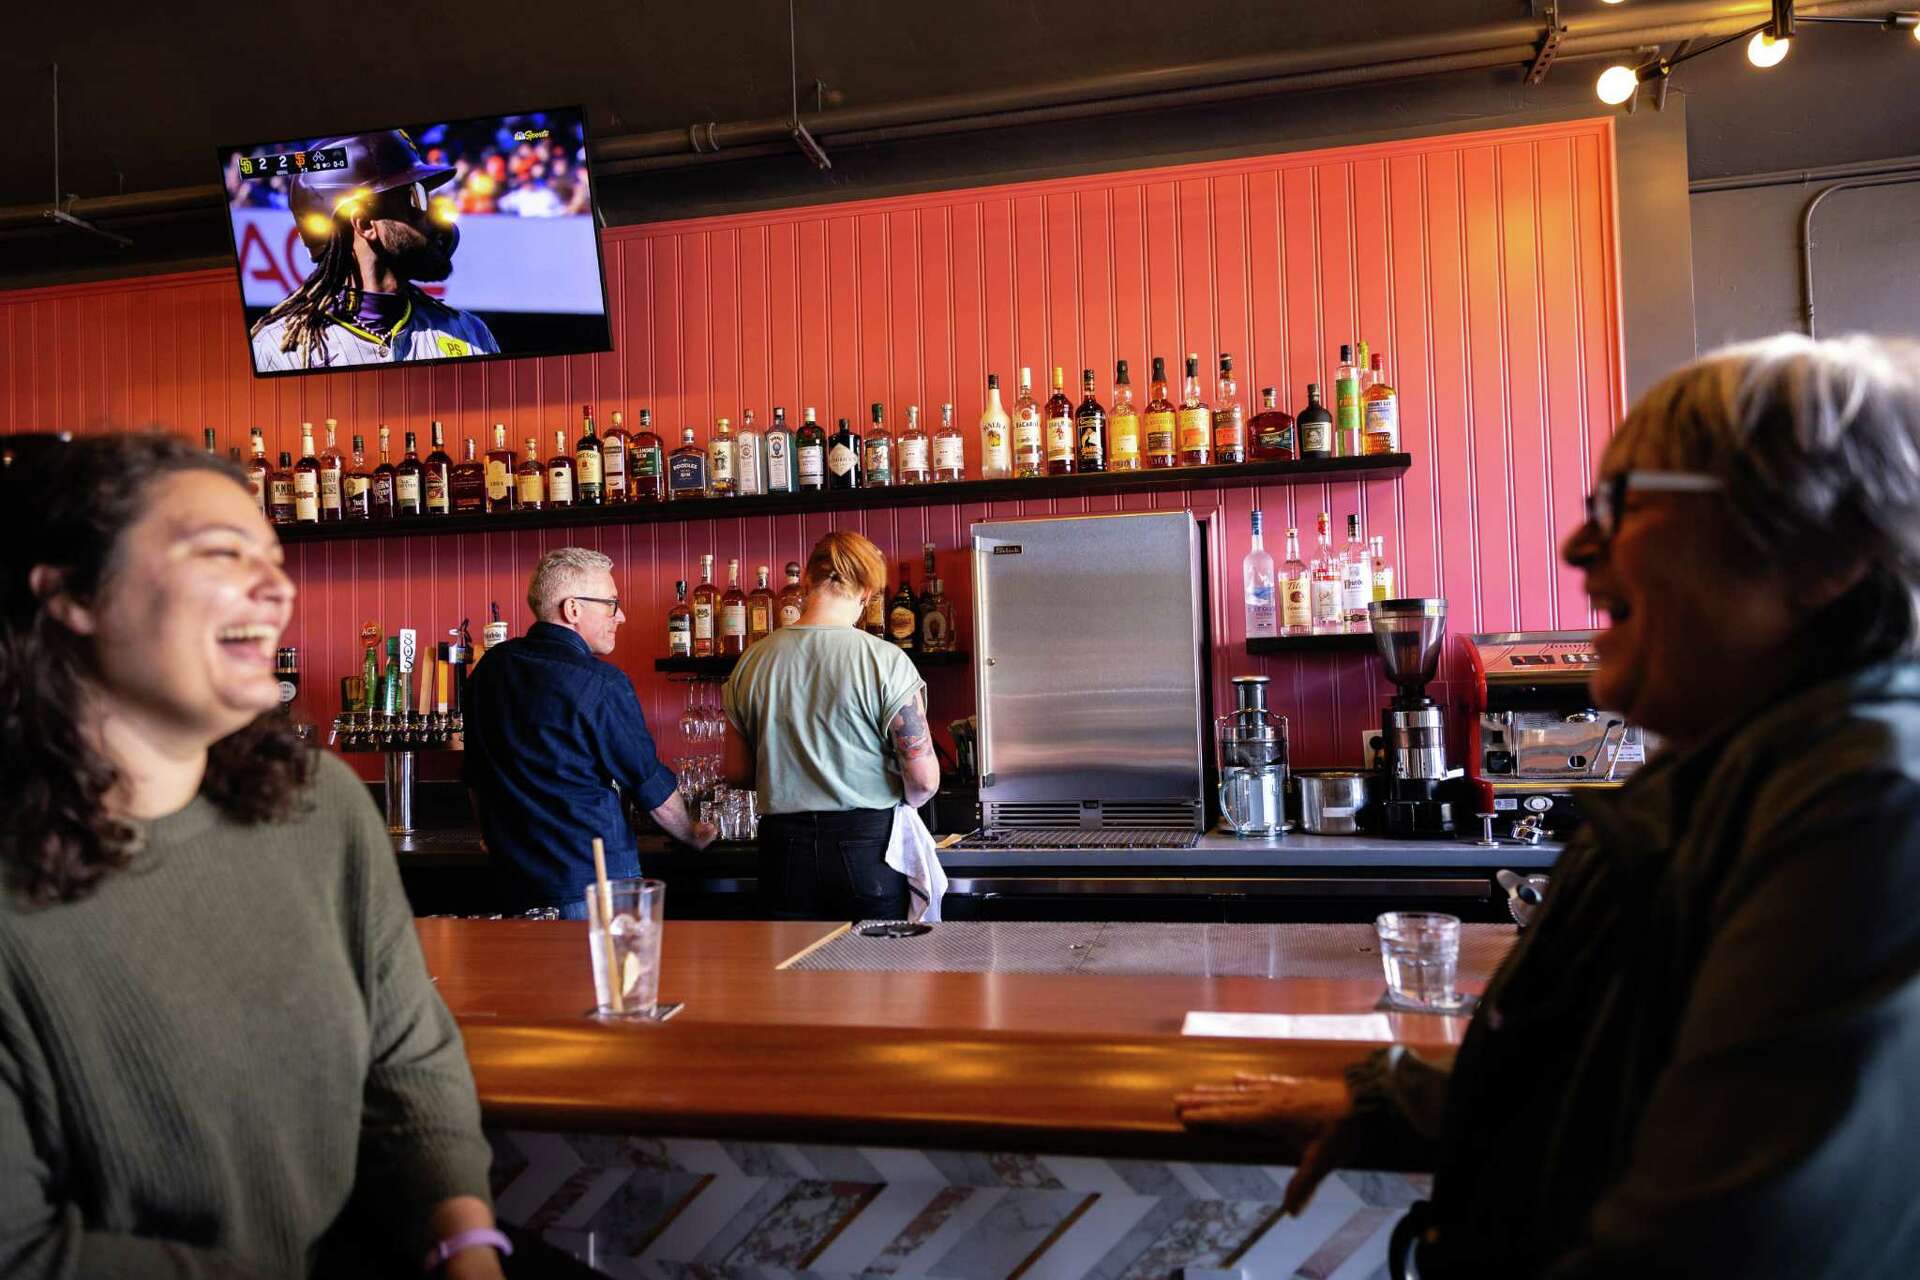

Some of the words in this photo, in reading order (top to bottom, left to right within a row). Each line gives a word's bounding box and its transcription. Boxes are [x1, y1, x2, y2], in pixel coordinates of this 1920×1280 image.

[259, 158, 267, 170] 2
[279, 156, 287, 167] 2
[403, 632, 414, 672] 805
